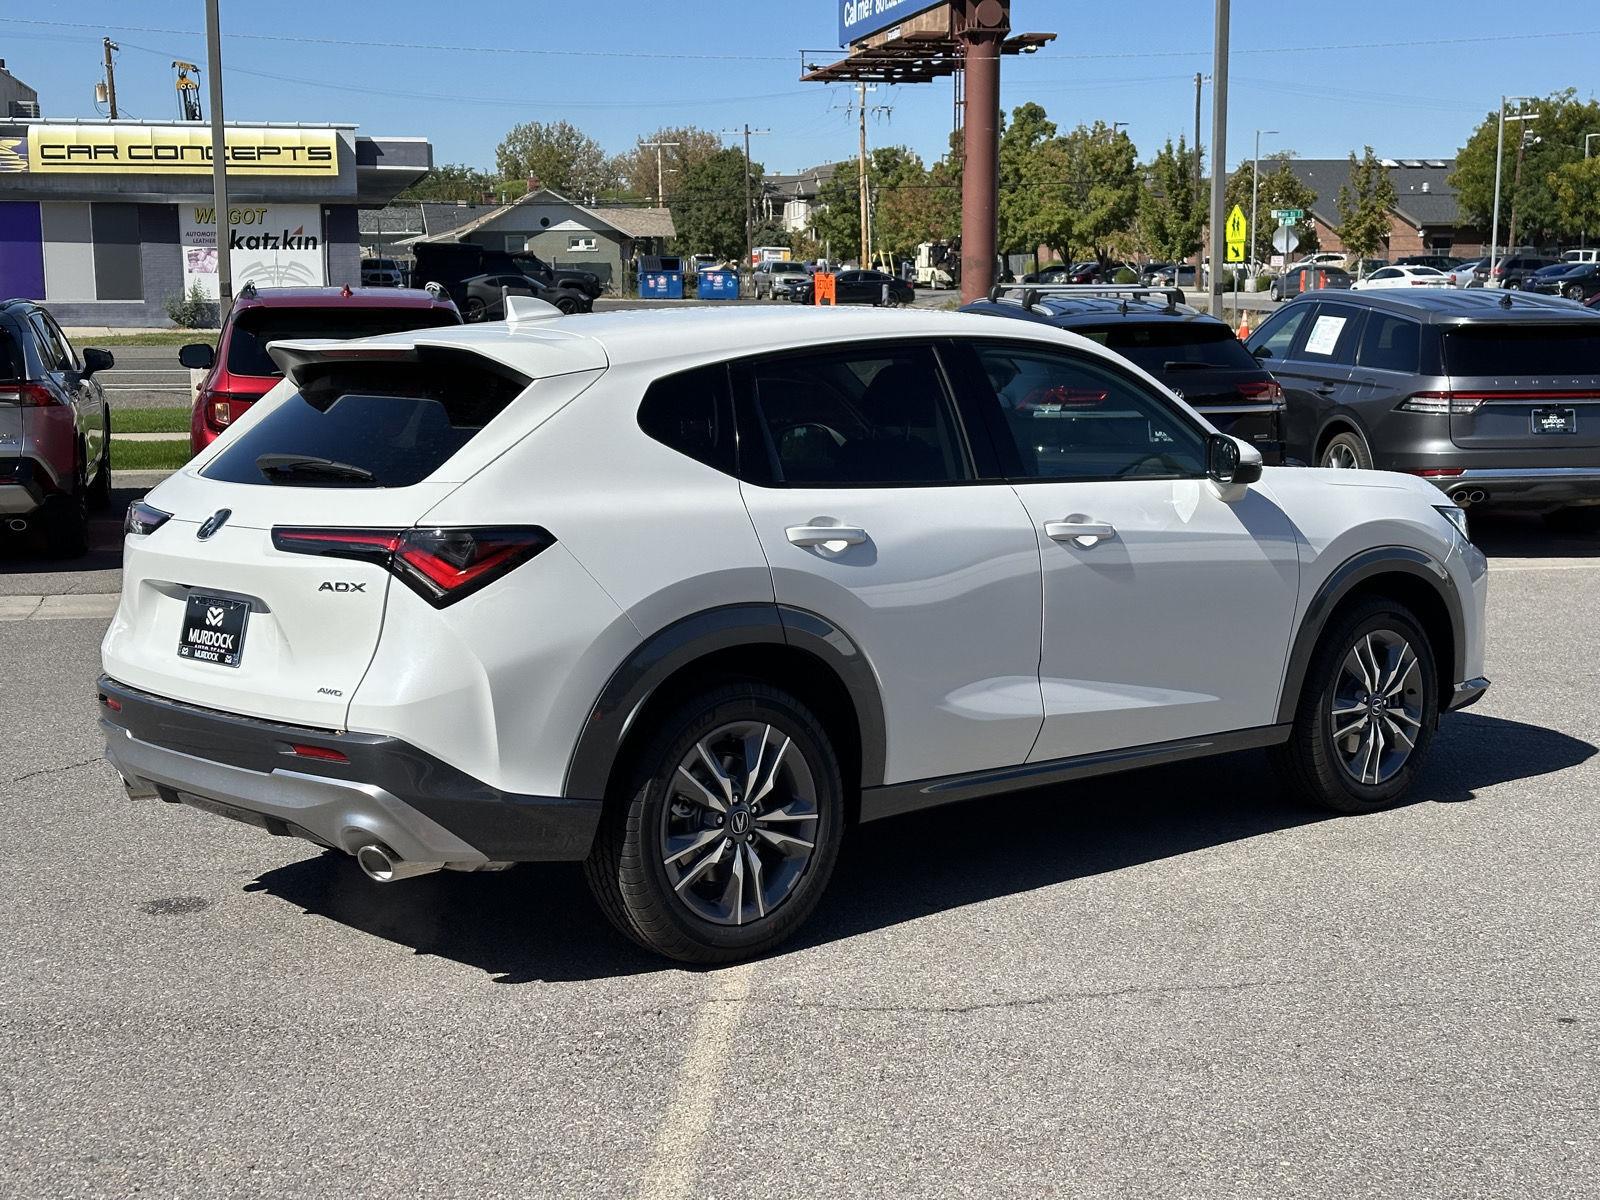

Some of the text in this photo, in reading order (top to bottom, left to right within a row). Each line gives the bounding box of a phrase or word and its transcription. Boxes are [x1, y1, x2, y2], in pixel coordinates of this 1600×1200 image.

[844, 0, 857, 27] Call
[40, 144, 332, 161] CAR CONCEPTS
[228, 208, 268, 225] GOT
[229, 225, 318, 251] katzkin
[318, 581, 367, 593] ADX
[188, 628, 235, 650] MURDOCK
[194, 649, 219, 662] MURDOCK
[316, 687, 343, 698] AWD
